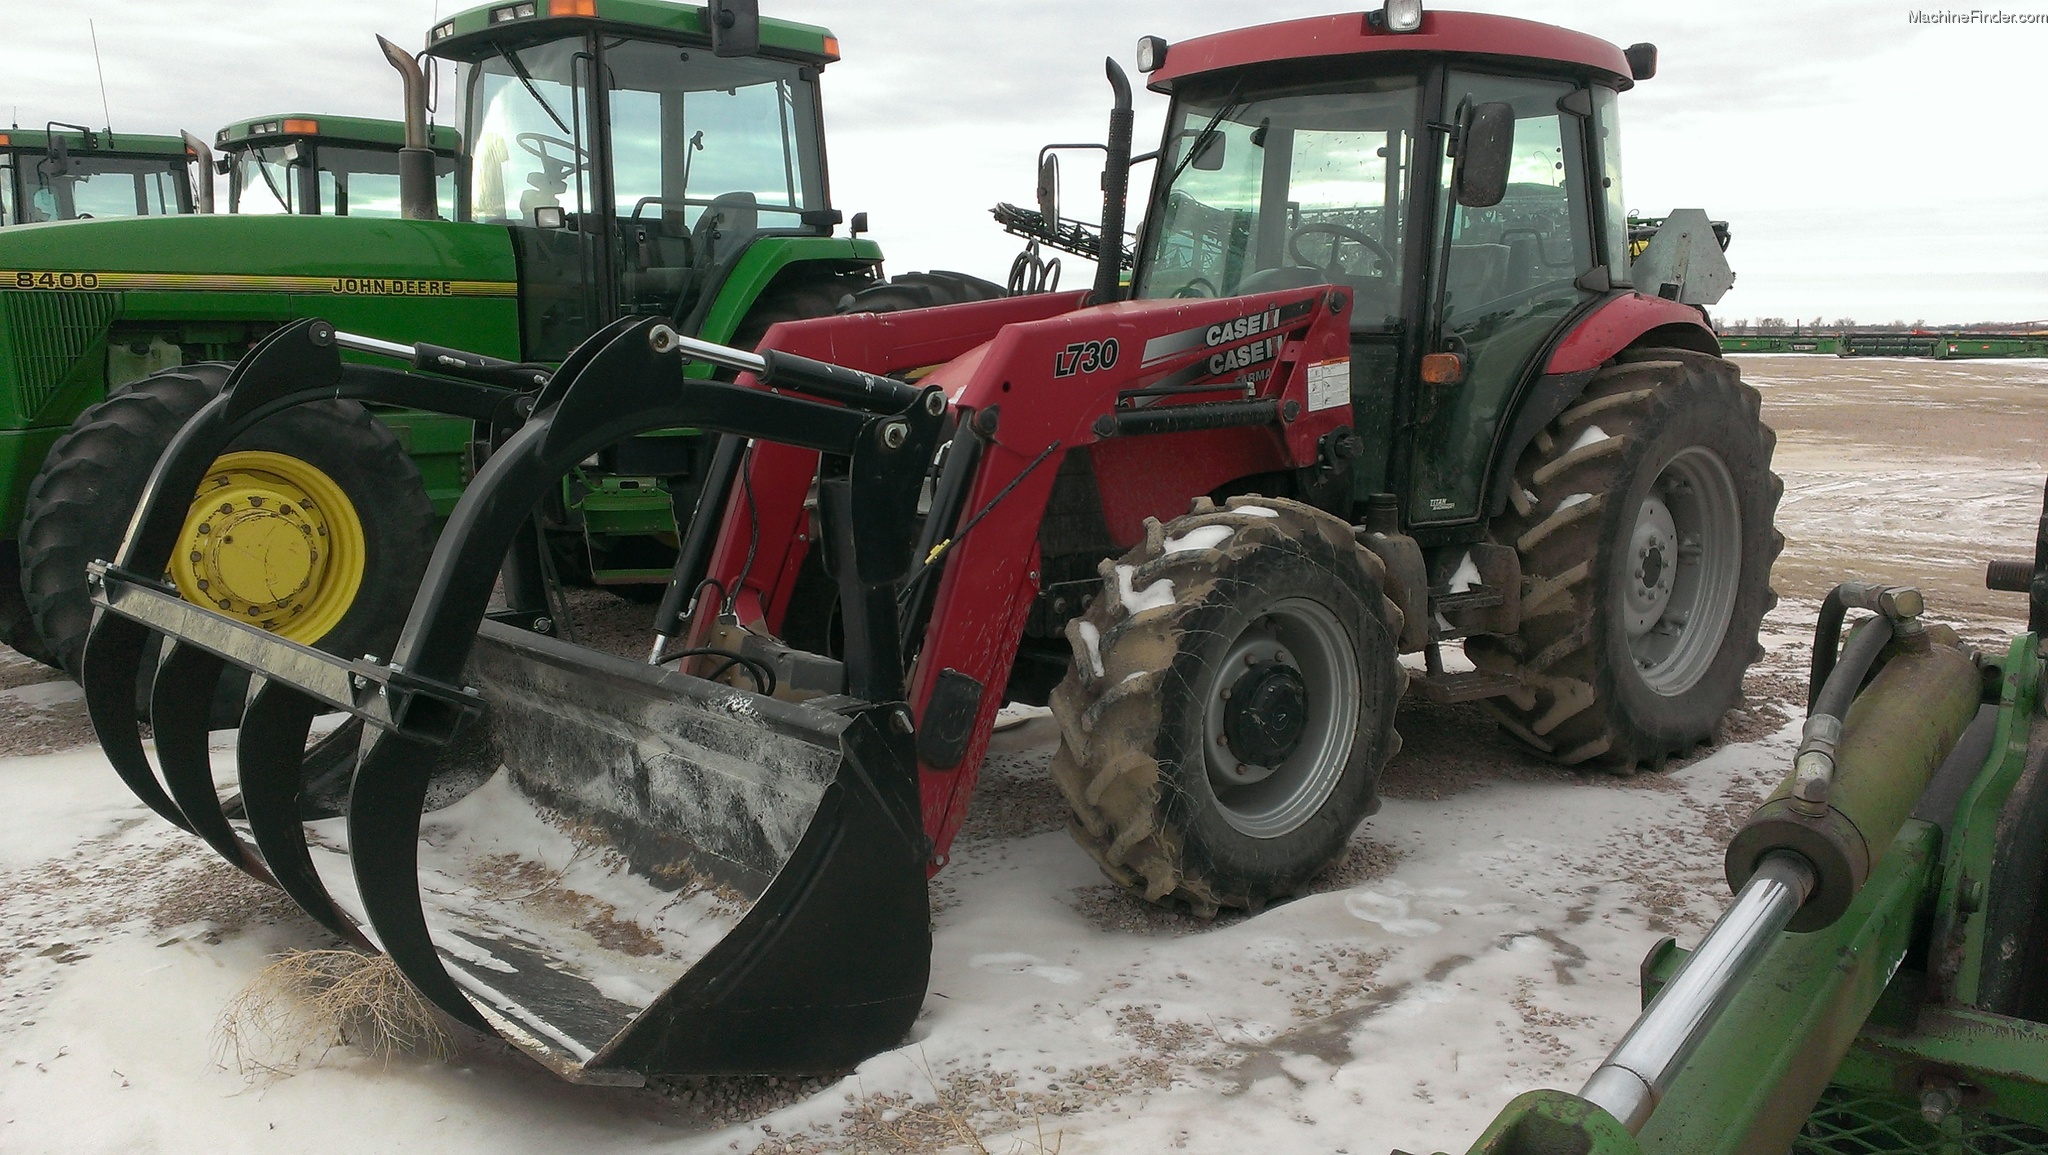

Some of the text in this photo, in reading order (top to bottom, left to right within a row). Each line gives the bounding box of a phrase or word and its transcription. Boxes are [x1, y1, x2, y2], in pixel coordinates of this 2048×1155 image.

[16, 272, 99, 290] 8400
[332, 279, 453, 295] JOHN DEERE
[1054, 337, 1120, 379] L730
